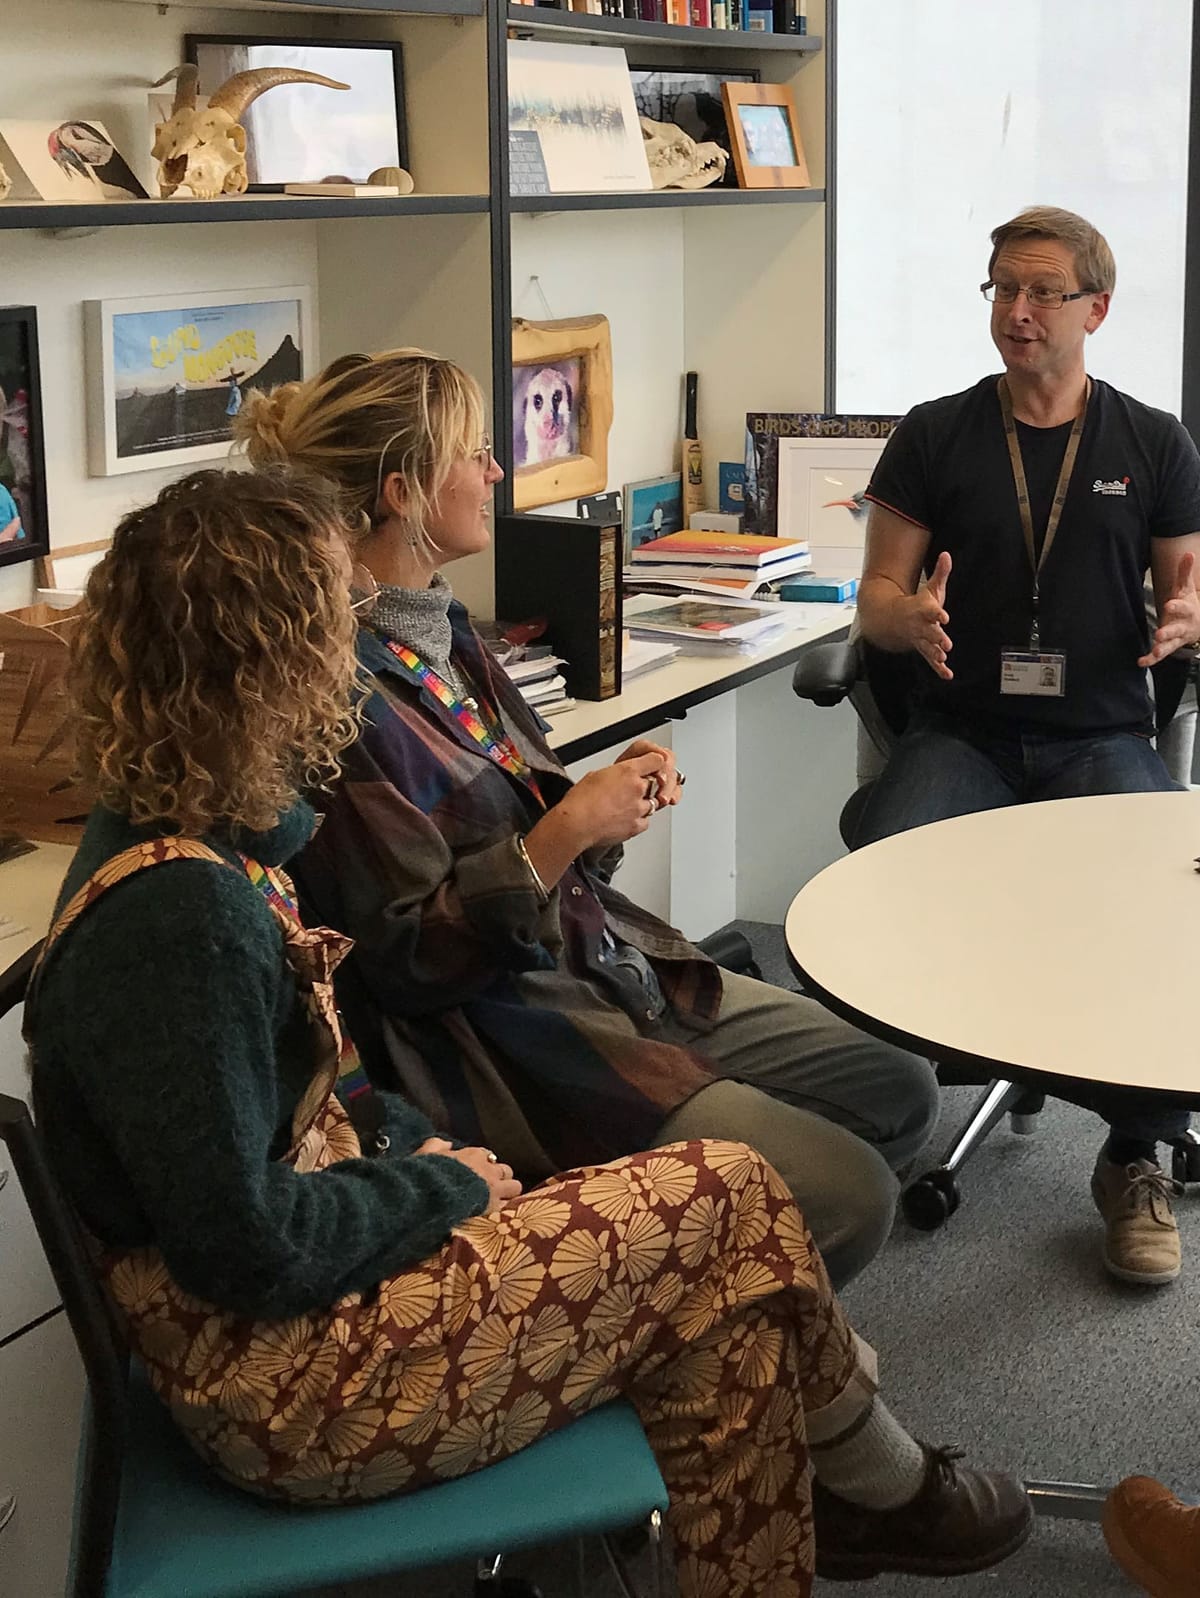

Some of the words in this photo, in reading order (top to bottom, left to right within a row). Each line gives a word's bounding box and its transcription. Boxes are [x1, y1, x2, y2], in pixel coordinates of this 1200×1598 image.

[754, 418, 800, 435] BIRDS
[807, 419, 842, 435] AND
[848, 419, 898, 437] PEOP
